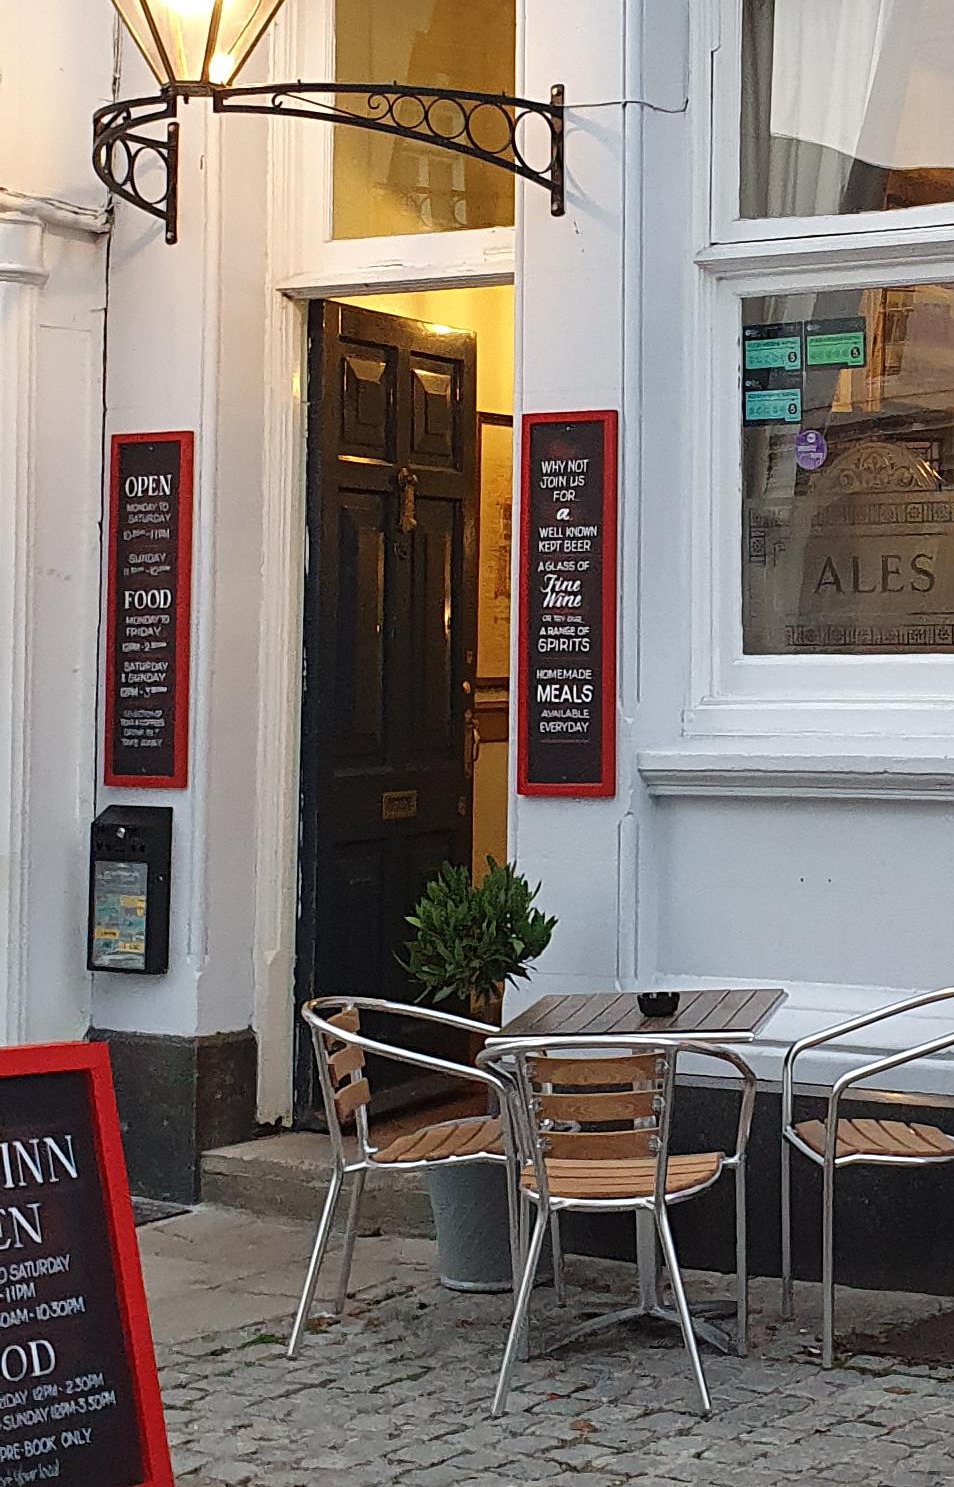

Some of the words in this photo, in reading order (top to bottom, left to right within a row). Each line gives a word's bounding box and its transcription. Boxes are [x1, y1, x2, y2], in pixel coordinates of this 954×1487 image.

[541, 461, 566, 474] WHY
[568, 459, 589, 473] NOT
[125, 474, 172, 497] OPEN
[540, 476, 567, 489] JOIN
[570, 475, 585, 487] US
[539, 527, 563, 538] WELL
[566, 526, 597, 537] KNOWN
[539, 541, 562, 553] KEPT
[564, 540, 591, 552] BEER
[129, 553, 166, 564] SUNDAY
[545, 561, 575, 571] GLASS
[578, 561, 590, 571] OF
[815, 554, 936, 594] ALES
[541, 574, 582, 593] Fine
[124, 589, 172, 610] FOOD
[543, 590, 582, 608] Wine
[126, 627, 161, 637] FRIDAY
[577, 626, 590, 635] OF
[537, 638, 590, 653] SPIRITS
[124, 661, 168, 672] SATURDAY
[536, 669, 592, 680] HOMEMADE
[537, 685, 593, 703] MEALS
[541, 709, 590, 719] AVAILABLE
[540, 721, 589, 733] EVERYDAY
[0, 1134, 78, 1189] INN
[9, 1254, 70, 1281] SATURDAY
[3, 1407, 48, 1431] SUNDAY
[61, 1427, 92, 1449] ONLY
